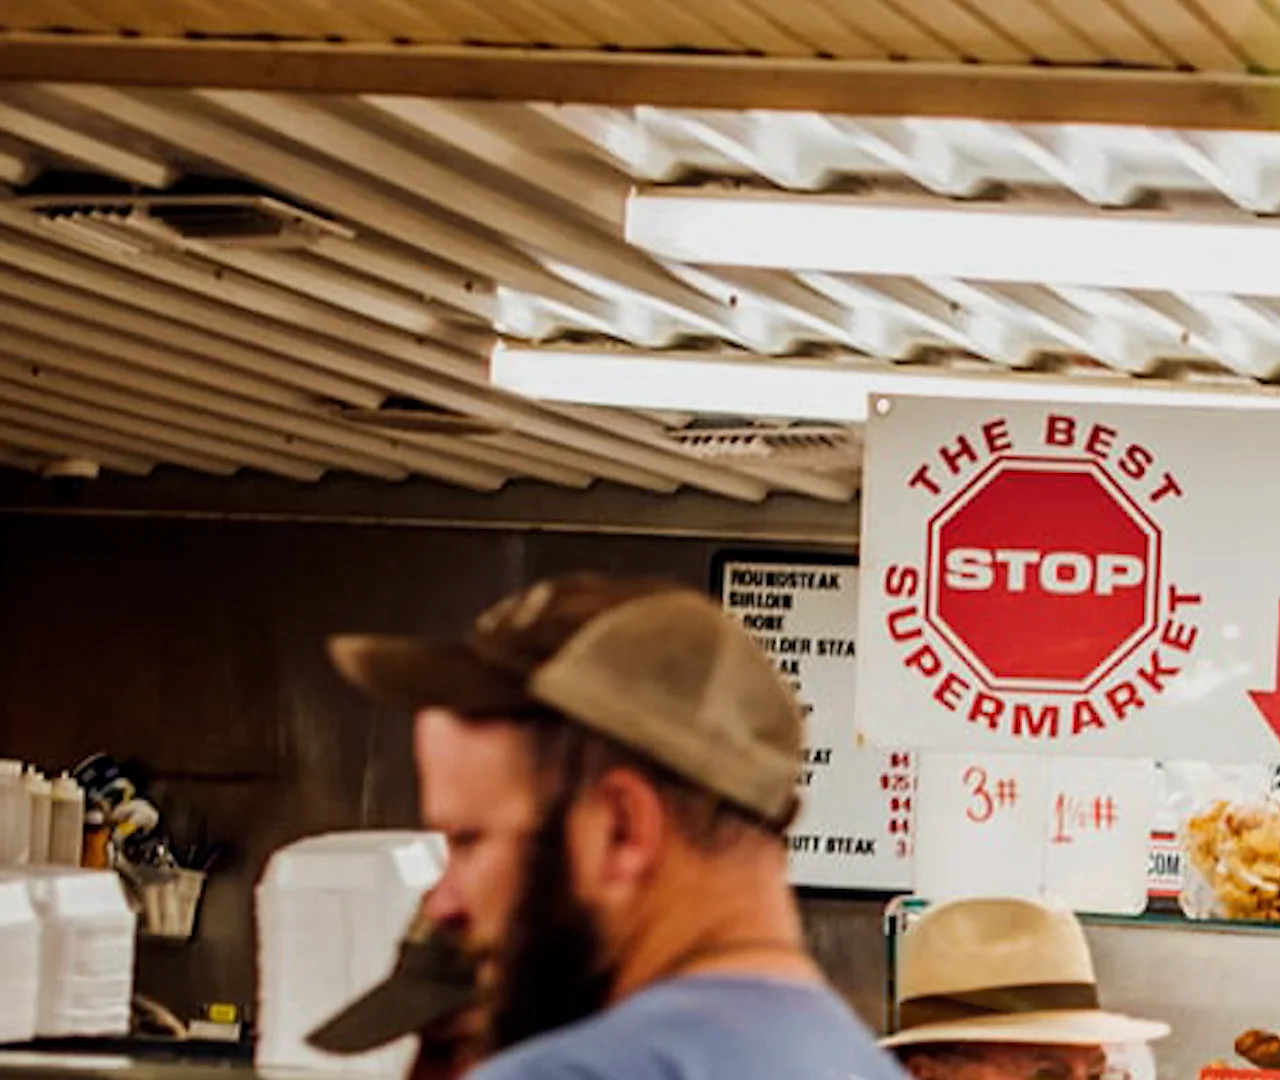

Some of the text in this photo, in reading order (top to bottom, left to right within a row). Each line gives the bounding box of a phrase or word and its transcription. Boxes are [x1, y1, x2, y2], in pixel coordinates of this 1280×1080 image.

[908, 415, 1184, 502] THE BEST
[944, 547, 1145, 596] STOP
[885, 564, 1203, 738] SUPERMARKET
